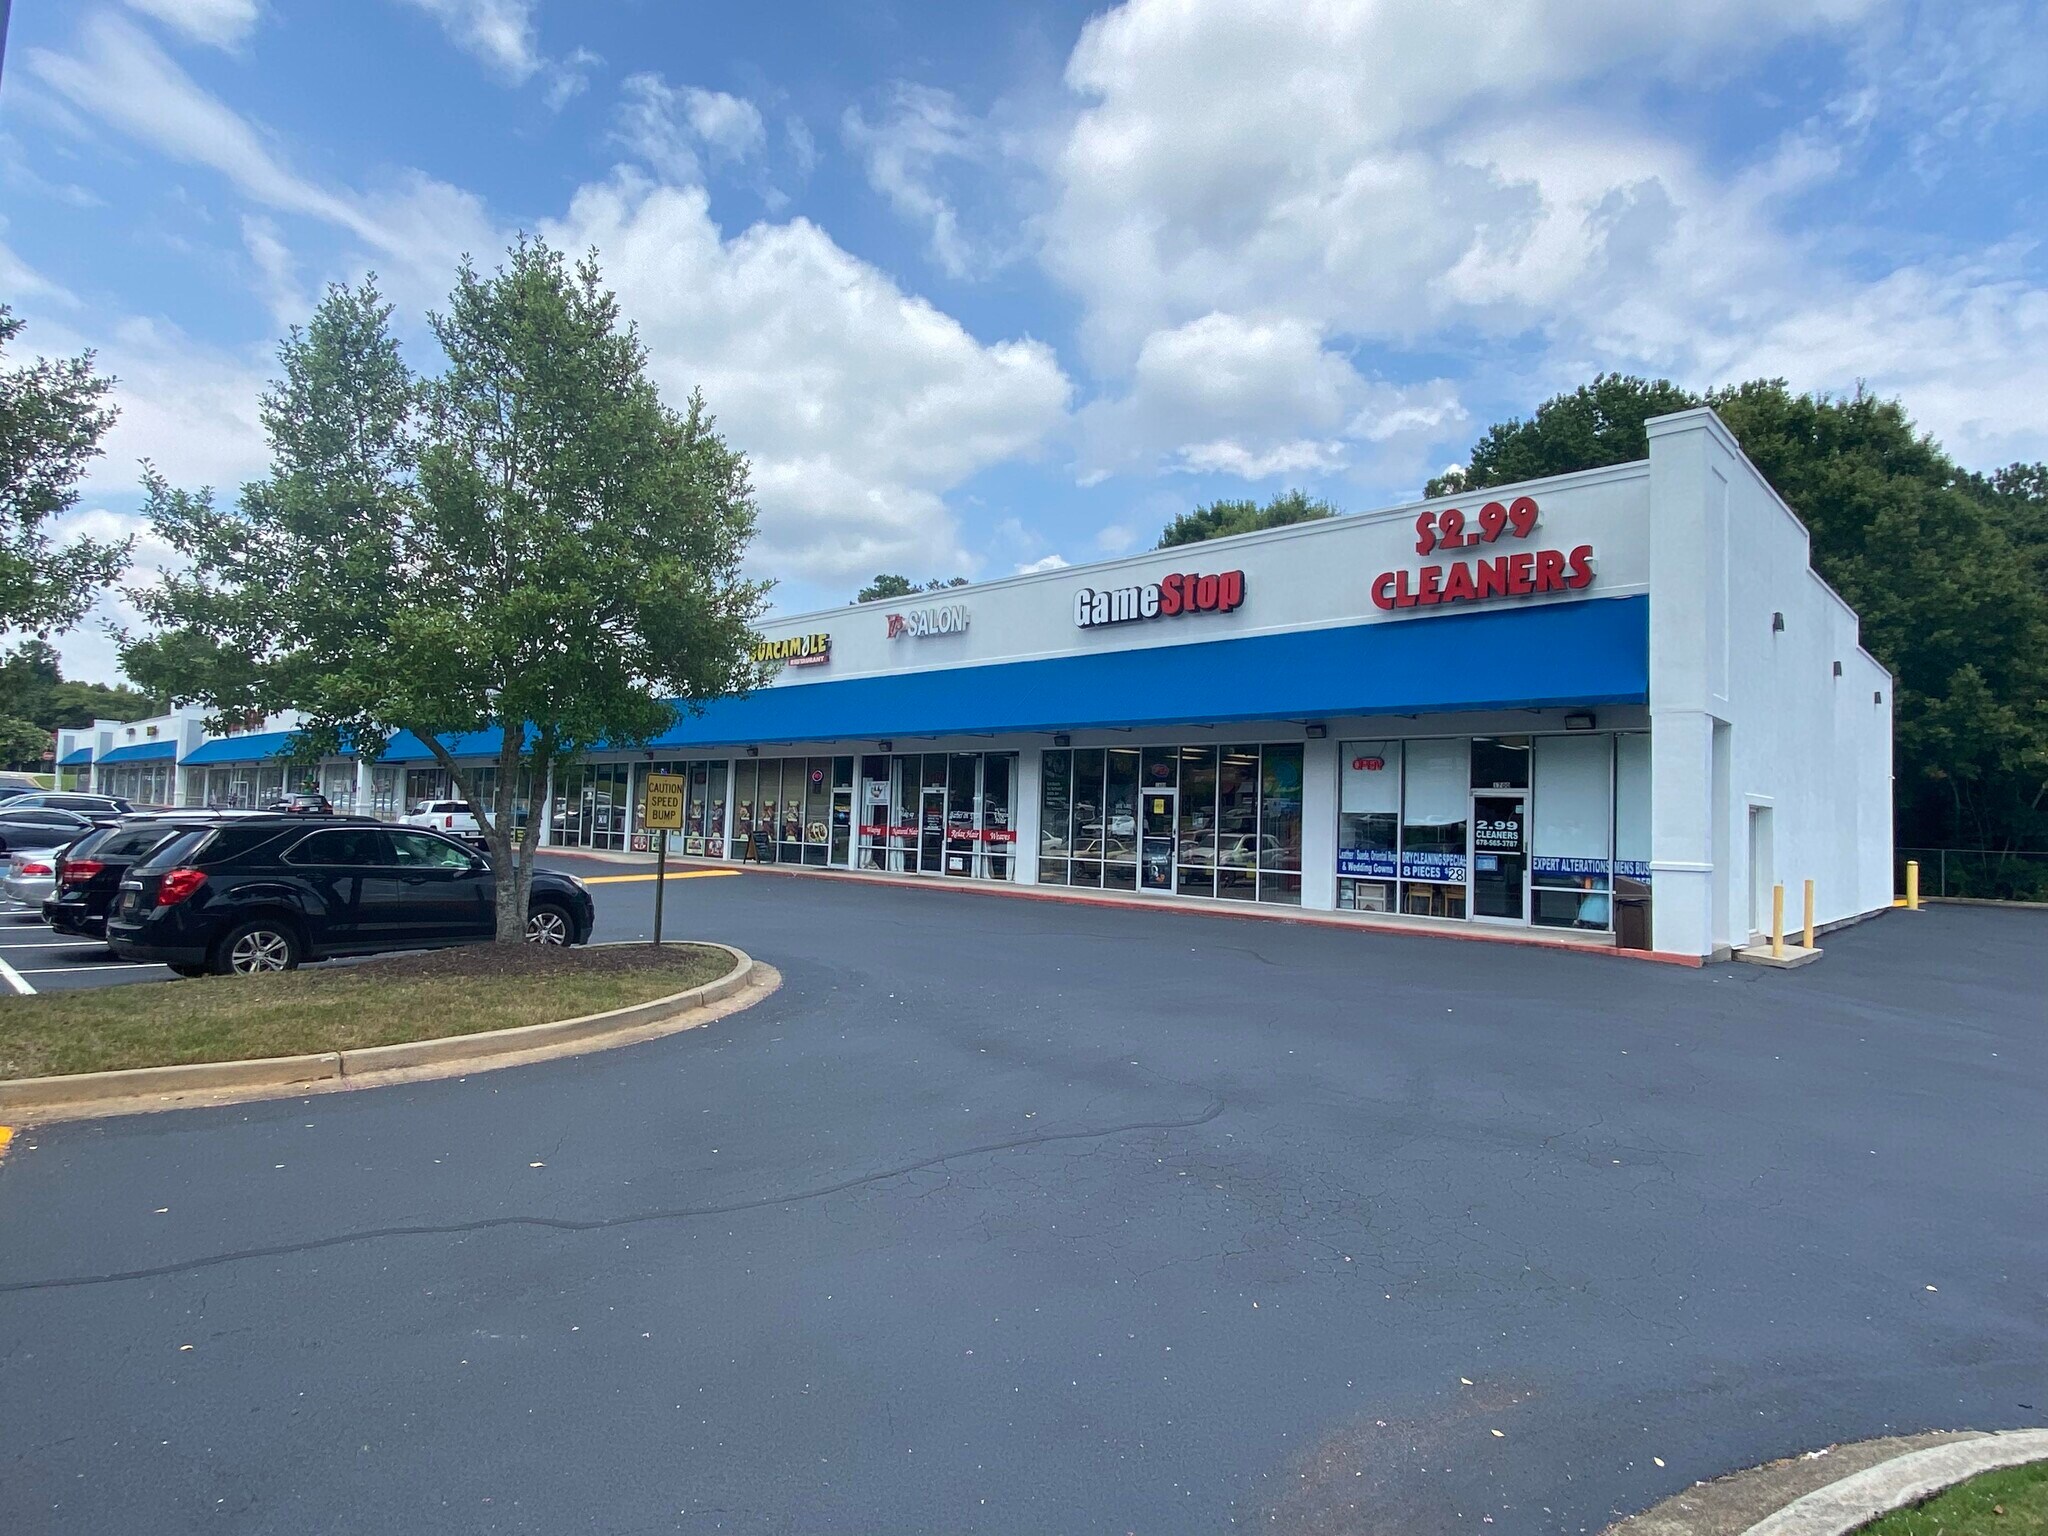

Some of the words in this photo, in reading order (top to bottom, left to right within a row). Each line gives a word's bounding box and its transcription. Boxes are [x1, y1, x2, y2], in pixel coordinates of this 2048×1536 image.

[1415, 496, 1540, 556] $2.99
[1371, 545, 1594, 610] CLEANERS
[1073, 570, 1245, 629] GameStop
[907, 605, 967, 637] SALON
[649, 782, 682, 794] CAUTION
[651, 796, 679, 807] SPEED
[652, 810, 676, 821] BUMP
[1476, 820, 1518, 831] 2.99
[1476, 830, 1519, 840] CLEANERS
[1342, 861, 1347, 871] &
[1348, 862, 1373, 874] Wedding
[1373, 863, 1394, 874] Gowns
[1533, 857, 1560, 871] EXPERT
[1560, 859, 1610, 873] ALTERATIONS
[1614, 861, 1635, 875] MENS
[1412, 867, 1441, 879] PIECES
